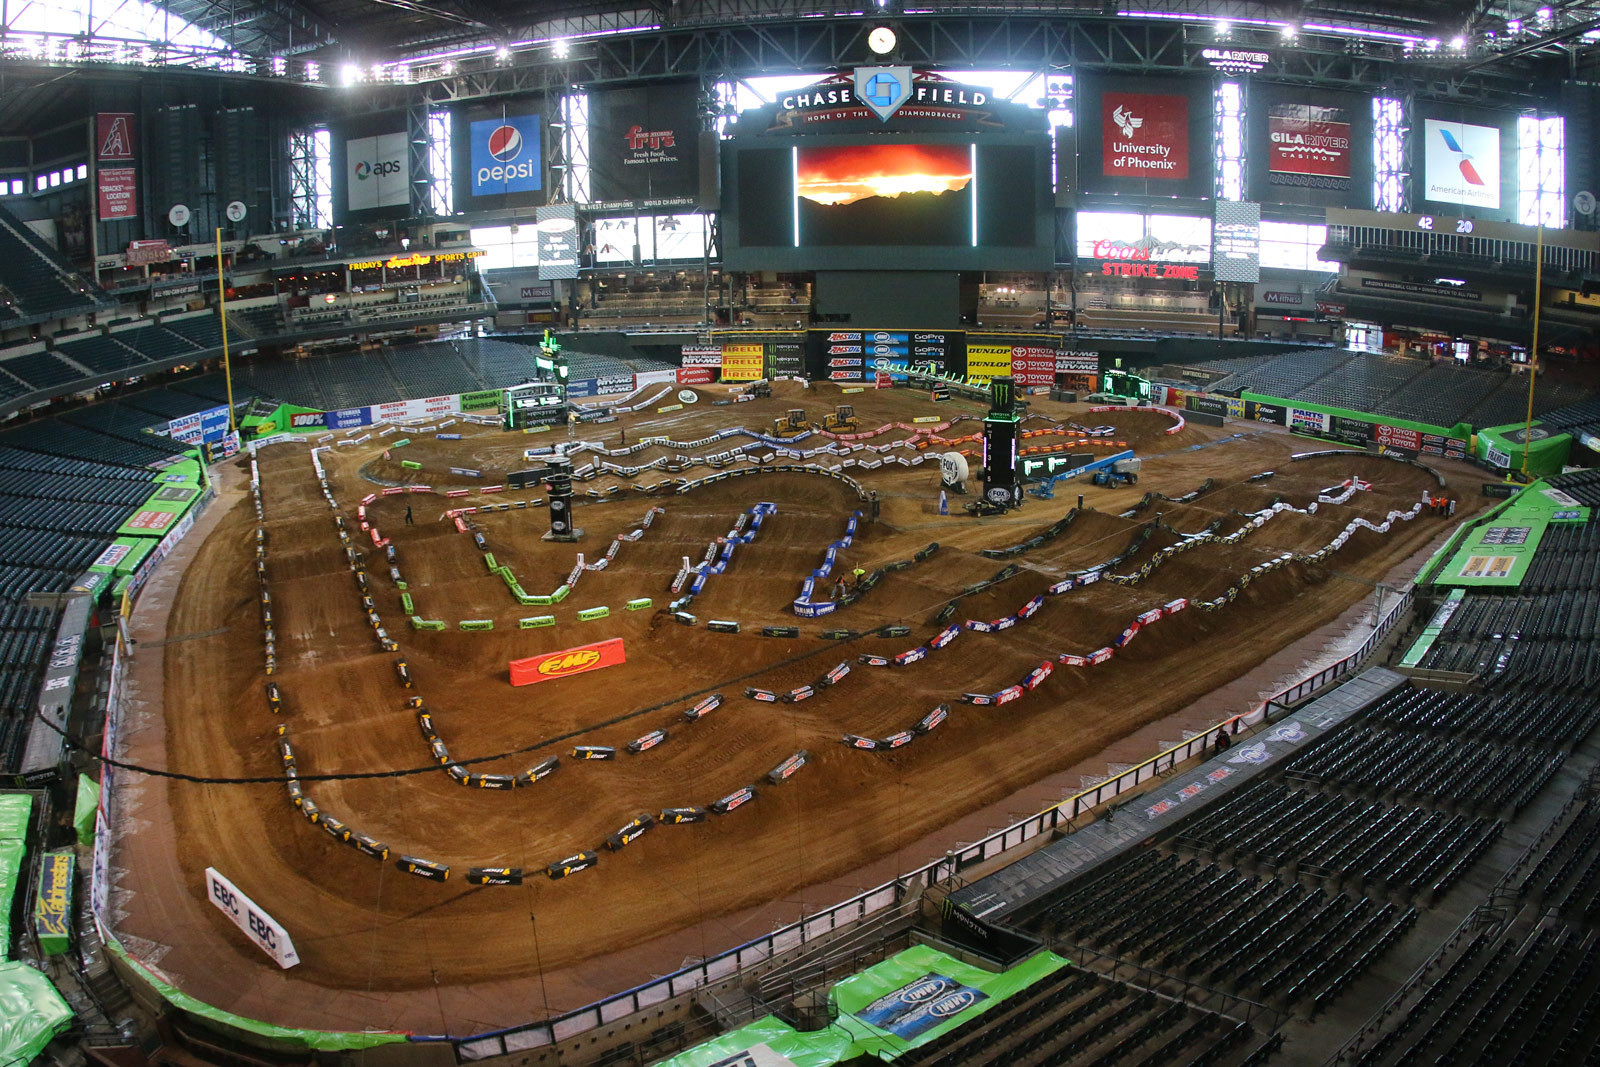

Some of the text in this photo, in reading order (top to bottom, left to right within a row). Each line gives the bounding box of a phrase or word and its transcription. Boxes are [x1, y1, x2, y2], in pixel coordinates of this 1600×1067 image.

[1202, 49, 1269, 62] GILA RIVER
[783, 88, 986, 109] CHASE FIELD
[807, 114, 830, 122] HOME
[899, 111, 961, 119] DIAMONDBACKS
[1271, 132, 1348, 149] GILA RIVER
[1113, 142, 1170, 156] University
[1113, 156, 1174, 170] of Phoenix
[1281, 153, 1335, 162] CASINOS
[373, 159, 401, 177] aps
[478, 159, 533, 187] pepsi
[1431, 185, 1496, 200] American Airlines
[1418, 216, 1433, 230] 42
[1456, 220, 1473, 233] 20
[1092, 239, 1150, 261] Coors
[349, 261, 382, 270] FRIDAYS
[435, 253, 465, 261] SPORTS
[1102, 263, 1199, 279] STRIKE ZONE
[828, 333, 861, 342] AMSOIL
[828, 345, 861, 354] AMSOIL
[828, 358, 861, 367] AMSOIL
[828, 371, 861, 380] AMSOIL
[462, 391, 500, 401] Kawasaki
[294, 414, 324, 426] 100%
[1293, 409, 1324, 419] PARTS
[171, 415, 199, 428] PARTS
[1393, 427, 1417, 437] TOYOTA
[1392, 438, 1416, 448] TOYOTA
[1384, 449, 1404, 457] thor
[943, 459, 954, 472] FOX
[1057, 583, 1073, 594] 100%
[582, 609, 609, 620] Kawasaki
[522, 619, 554, 627] Kawasaki
[974, 624, 991, 632] 100%
[540, 651, 599, 673] FMF
[904, 651, 925, 664] 100%
[1068, 658, 1084, 666] 100%
[1032, 667, 1051, 688] 100%
[1000, 690, 1020, 704] 100%
[536, 768, 552, 780] thor
[628, 828, 645, 841] thor
[414, 867, 433, 878] thor
[569, 863, 588, 874] thor
[213, 878, 239, 915] EBC
[248, 909, 276, 950] EBC
[953, 909, 988, 939] MONSTER
